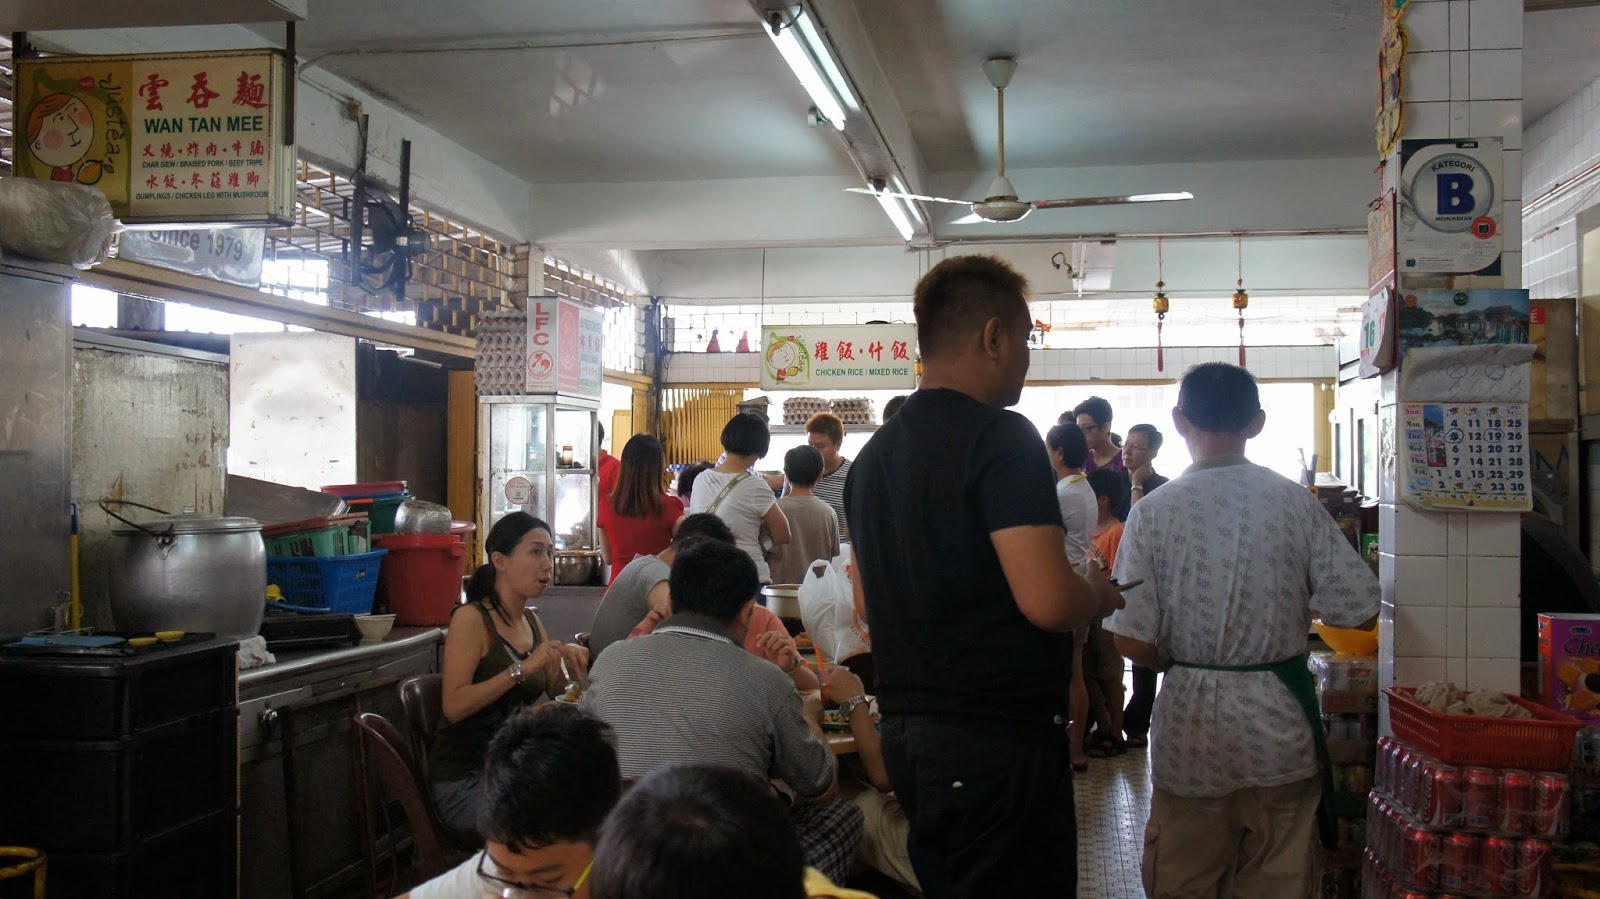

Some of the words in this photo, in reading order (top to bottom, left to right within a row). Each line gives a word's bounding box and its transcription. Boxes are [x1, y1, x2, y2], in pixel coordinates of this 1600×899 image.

[138, 70, 269, 111] 雲吞麵
[144, 117, 183, 133] WAN
[188, 116, 221, 132] TAN
[227, 115, 263, 131] MEE
[179, 160, 206, 168] BRAISED
[229, 159, 244, 167] BEEF
[1431, 160, 1475, 172] KATEGORI
[136, 192, 171, 200] DUMPLINGS
[233, 190, 269, 198] MUSHROOM
[1436, 173, 1475, 215] B
[207, 234, 243, 261] 1979
[1364, 320, 1375, 348] 16
[815, 368, 846, 376] CHICKEN
[847, 368, 864, 376] RICE
[869, 368, 891, 376] MIXED
[892, 368, 909, 376] RICE
[1450, 419, 1458, 428] 4
[1468, 419, 1480, 427] 11
[1487, 419, 1501, 427] 18
[1507, 419, 1521, 427] 25
[1468, 432, 1482, 440] 12
[1488, 432, 1502, 440] 19
[1452, 445, 1459, 453] 6
[1469, 445, 1482, 453] 13
[1488, 445, 1502, 453] 20
[1508, 445, 1523, 453] 27
[1453, 457, 1460, 465] 7
[1469, 457, 1483, 465] 14
[1488, 457, 1502, 465] 21
[1508, 457, 1523, 465] 28
[1436, 469, 1442, 477] 1
[1455, 470, 1461, 478] 8
[1471, 470, 1484, 478] 15
[1489, 470, 1504, 478] 22
[1509, 470, 1524, 478] 29
[1490, 483, 1505, 491] 23
[1510, 483, 1525, 491] 30
